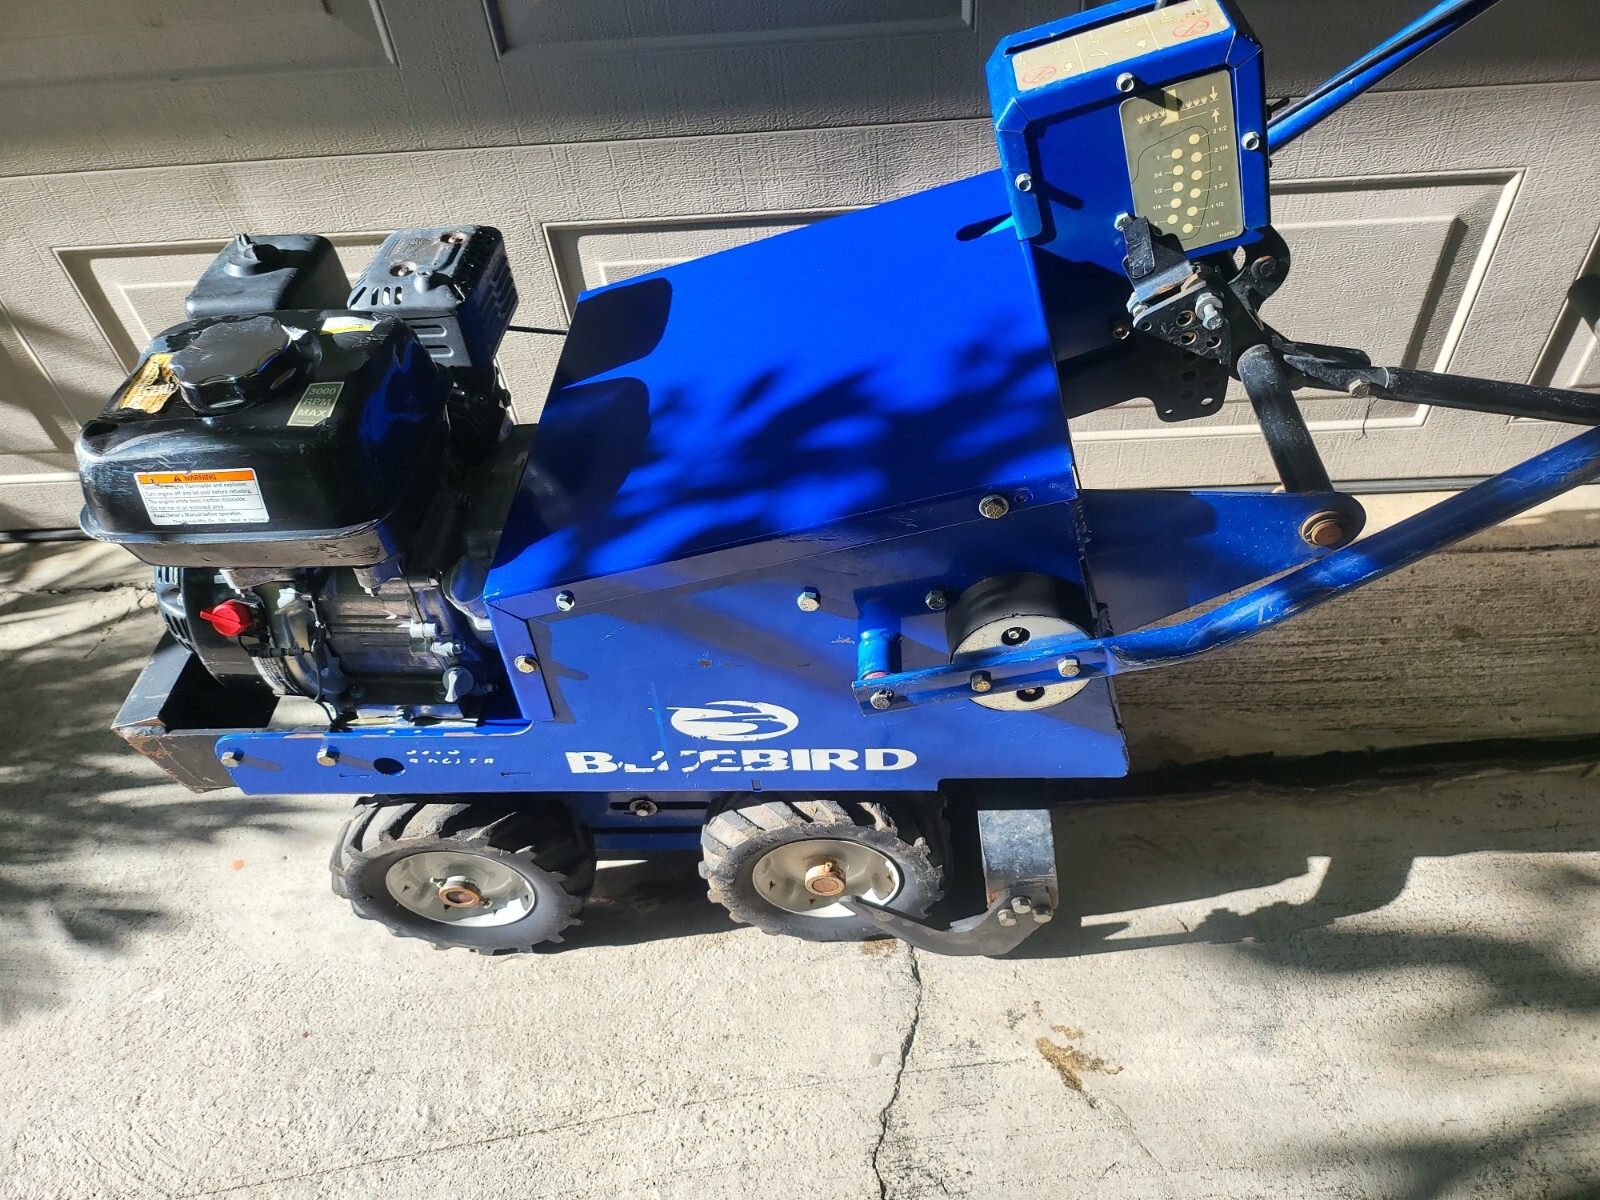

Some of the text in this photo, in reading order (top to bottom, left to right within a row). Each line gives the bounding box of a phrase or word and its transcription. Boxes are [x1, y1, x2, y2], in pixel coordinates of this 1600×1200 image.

[309, 387, 337, 395] 3000
[302, 397, 331, 406] RPM
[297, 408, 328, 417] MAX
[184, 473, 217, 481] WARNING
